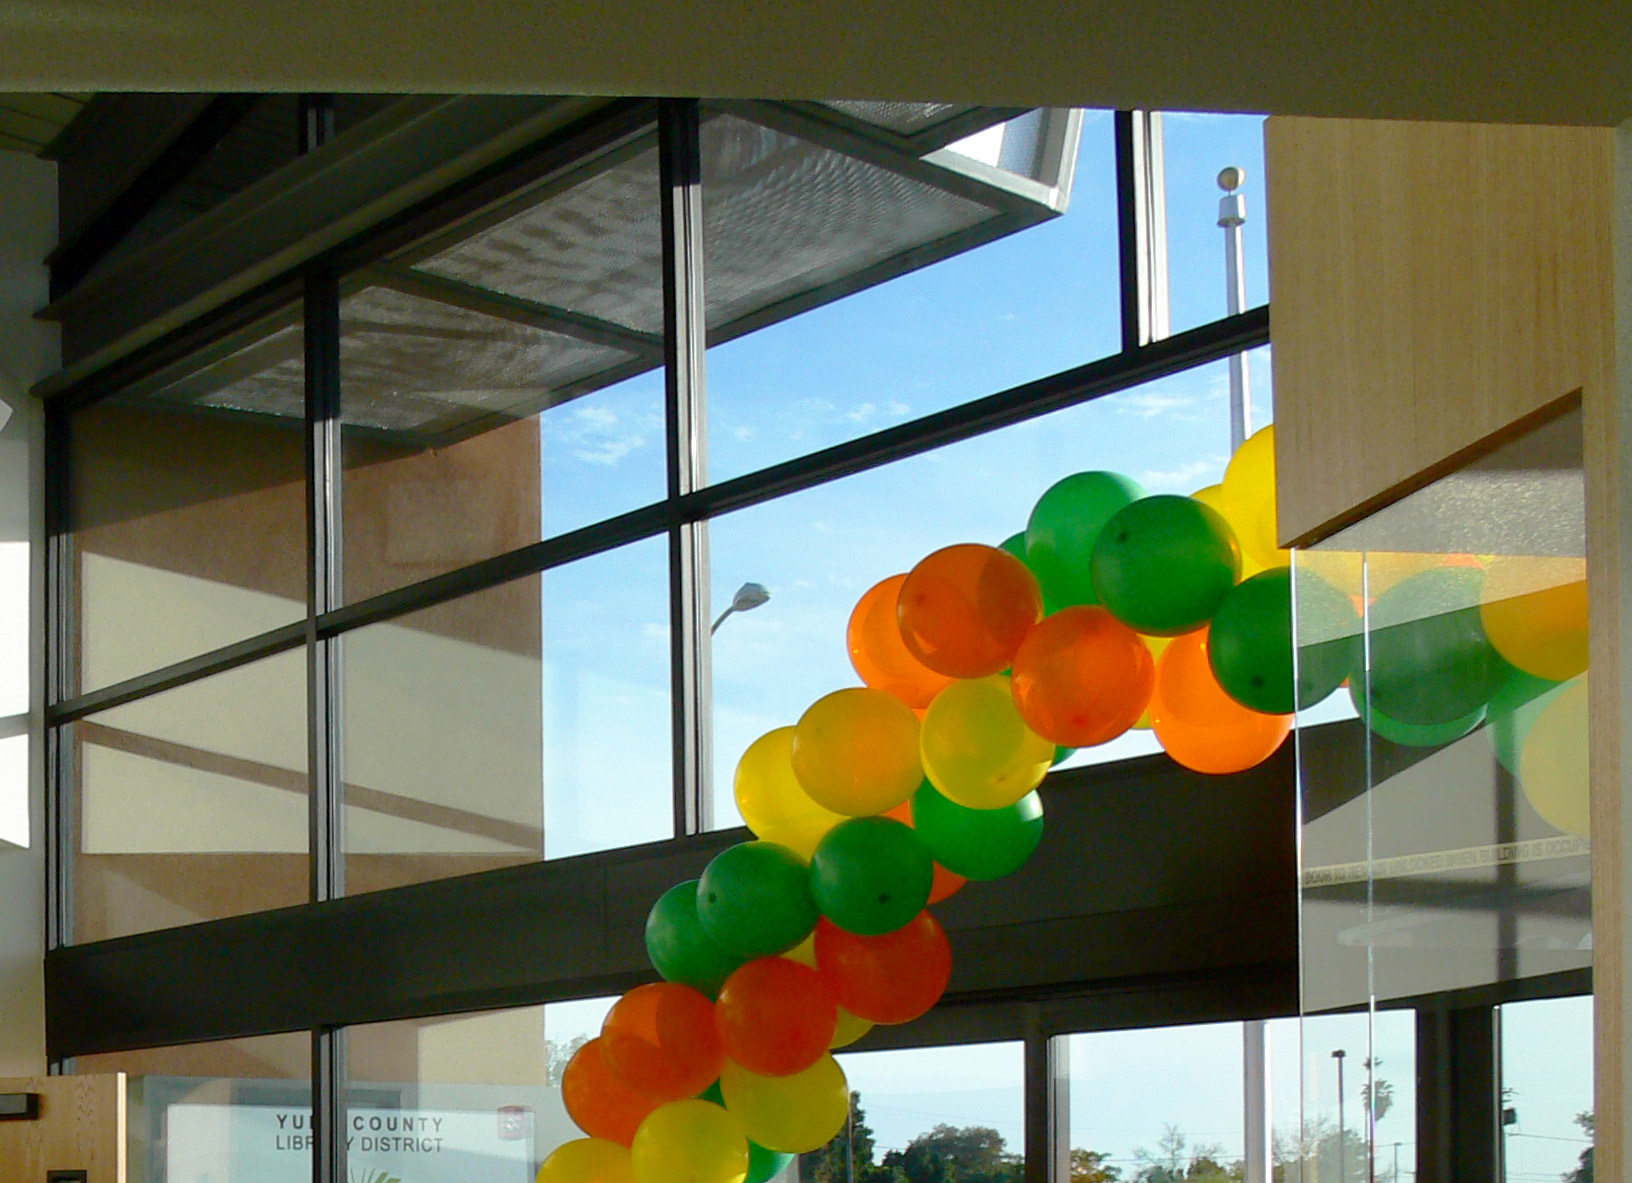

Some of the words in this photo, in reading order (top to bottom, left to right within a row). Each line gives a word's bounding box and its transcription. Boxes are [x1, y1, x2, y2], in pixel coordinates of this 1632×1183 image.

[1545, 837, 1591, 856] OCCUPIE
[353, 1116, 444, 1132] COUNTY
[361, 1137, 444, 1153] DISTRICT
